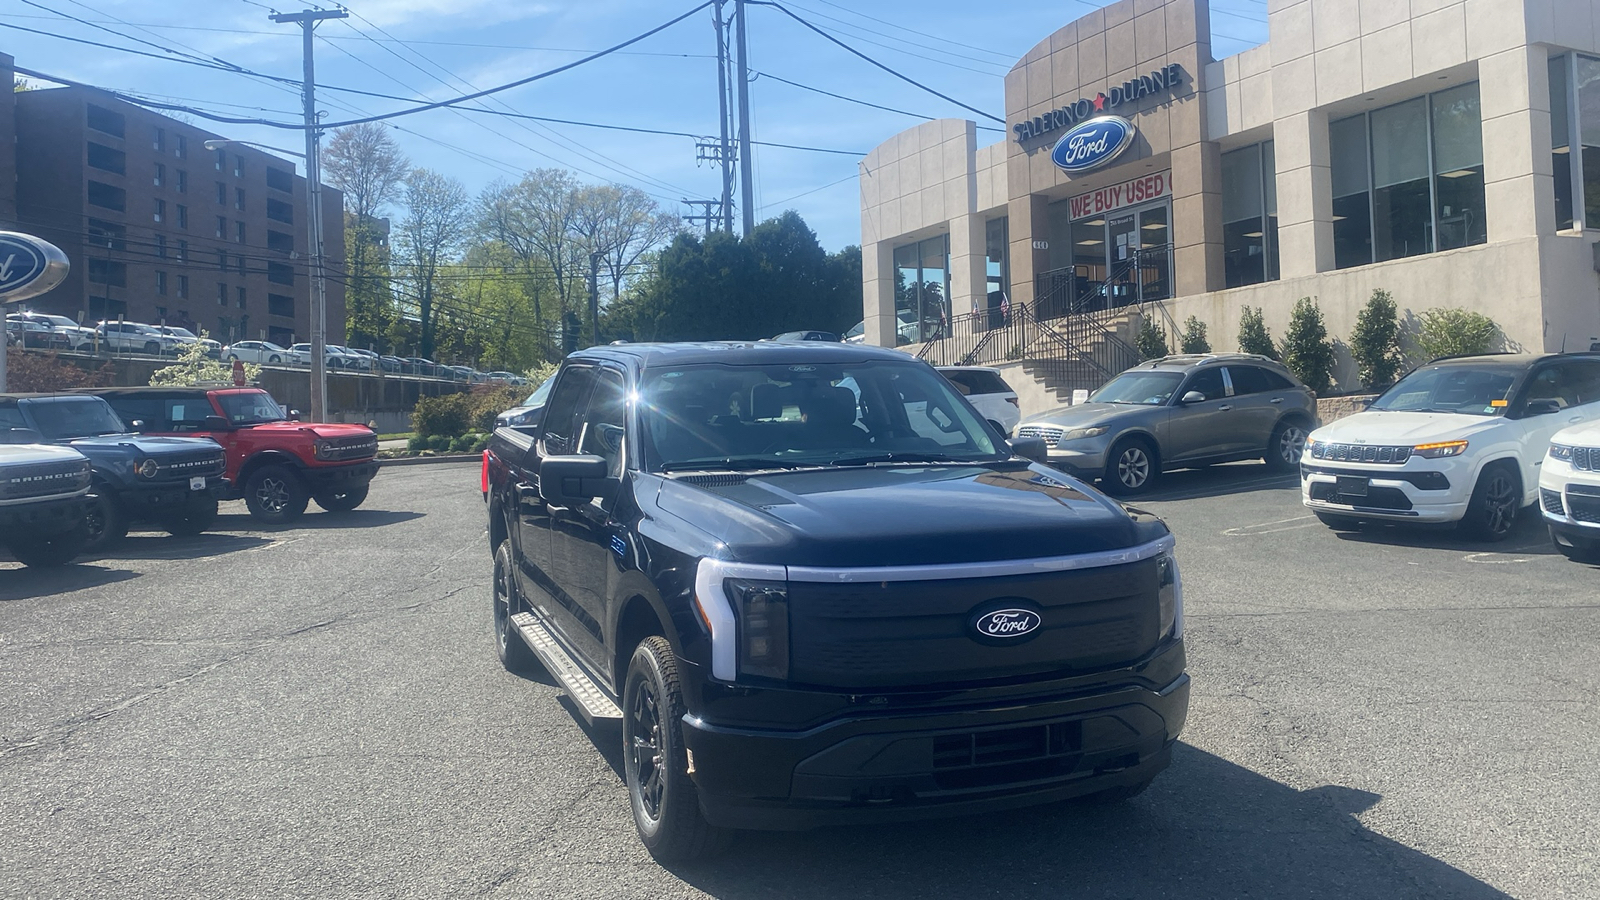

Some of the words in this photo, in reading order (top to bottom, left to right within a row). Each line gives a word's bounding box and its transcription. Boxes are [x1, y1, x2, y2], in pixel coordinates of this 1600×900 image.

[1012, 97, 1093, 144] SALERNO
[1109, 63, 1182, 108] DUANE
[1065, 129, 1109, 164] Ford
[1070, 194, 1091, 219] WE
[1095, 185, 1122, 212] BUY
[1126, 175, 1164, 204] USED
[11, 472, 73, 483] BRONCO
[171, 460, 215, 469] BRONCO
[988, 613, 1030, 633] Ford
